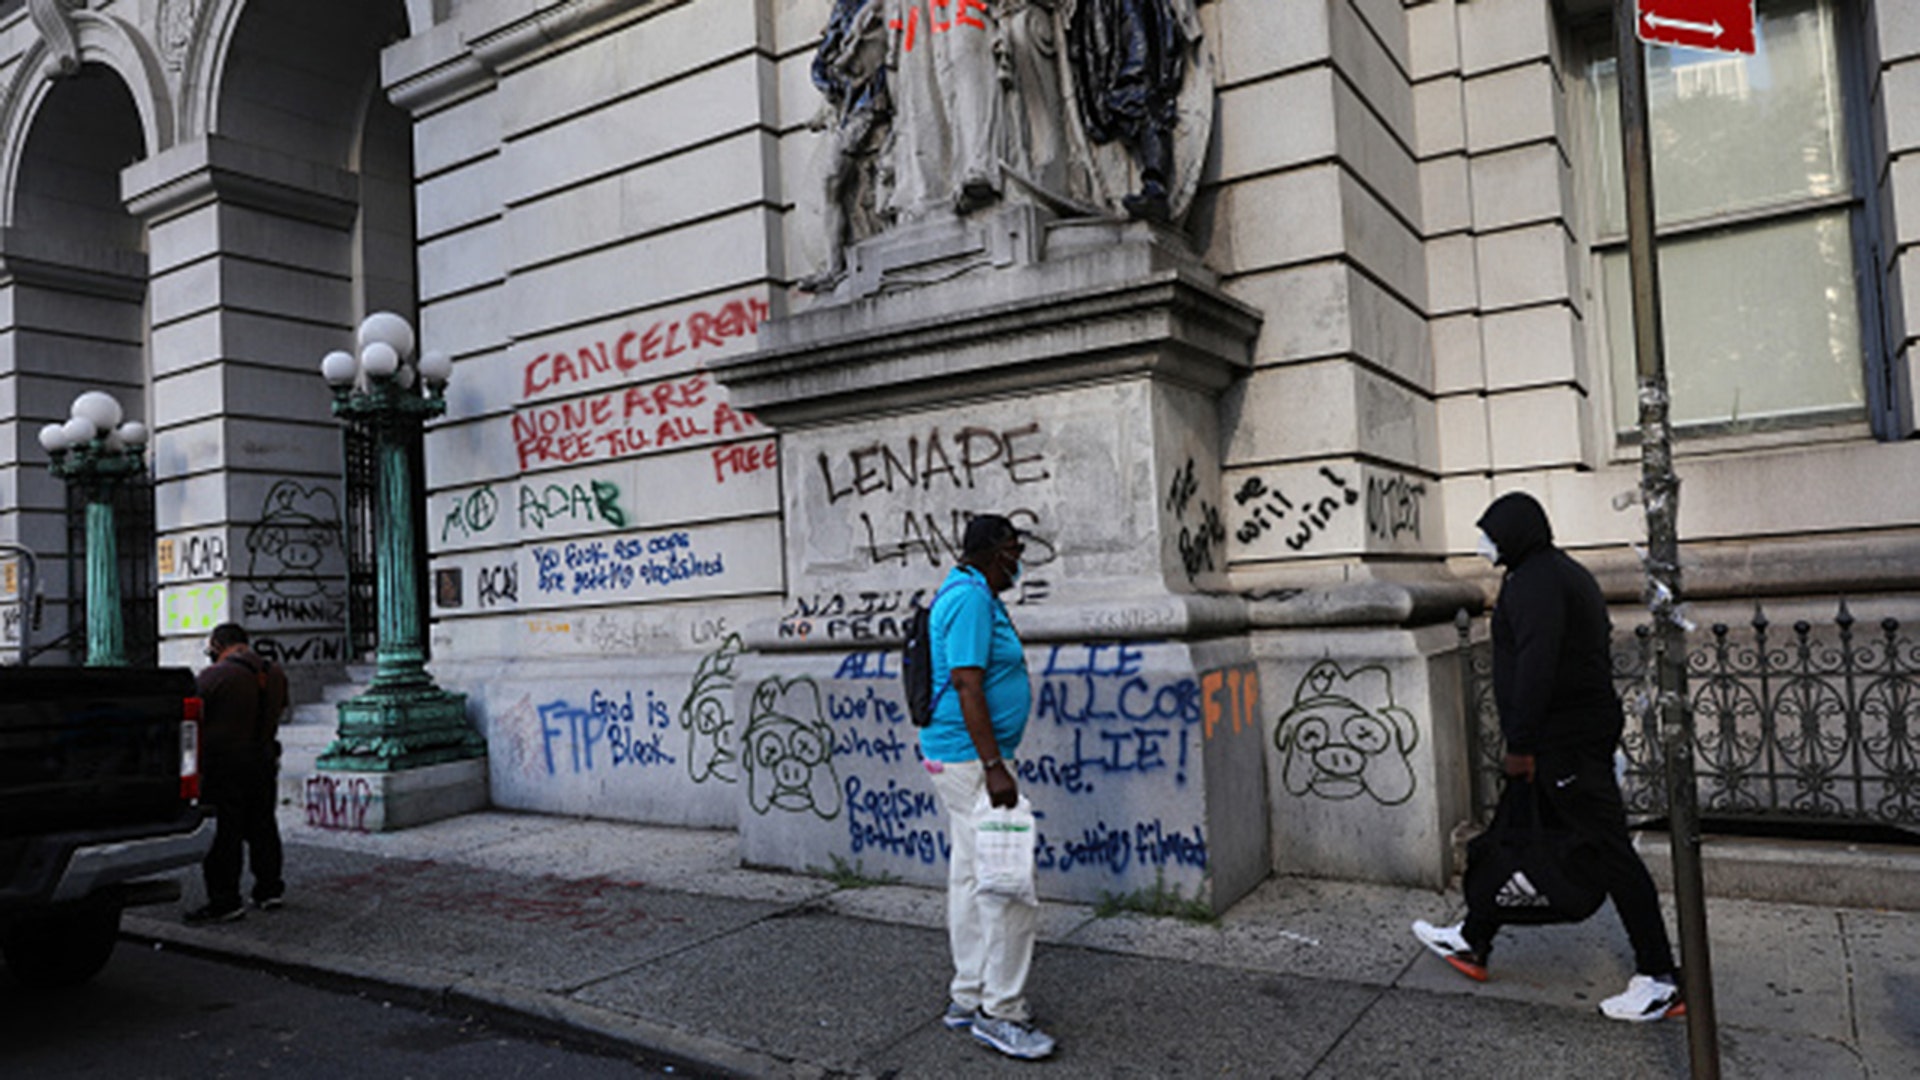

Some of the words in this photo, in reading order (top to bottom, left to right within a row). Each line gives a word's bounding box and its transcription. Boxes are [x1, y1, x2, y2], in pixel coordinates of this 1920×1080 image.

[511, 395, 613, 443] NONE
[623, 371, 710, 420] ARE
[517, 429, 596, 471] FREE
[656, 413, 708, 447] ALL
[711, 442, 777, 484] FREE
[817, 421, 1051, 504] LENAPE
[518, 479, 627, 530] ACAB
[1236, 490, 1294, 545] will
[178, 535, 229, 578] ACAB
[859, 507, 1056, 568] LANS
[779, 621, 813, 638] NO
[834, 651, 898, 680] ALL
[1043, 642, 1143, 677] LIE
[646, 690, 670, 729] is
[1036, 674, 1118, 726] ALL
[1201, 668, 1259, 740] FTP
[537, 699, 608, 775] FTP
[827, 728, 907, 764] what
[1074, 727, 1189, 789] LIE!
[844, 775, 938, 820] Racism
